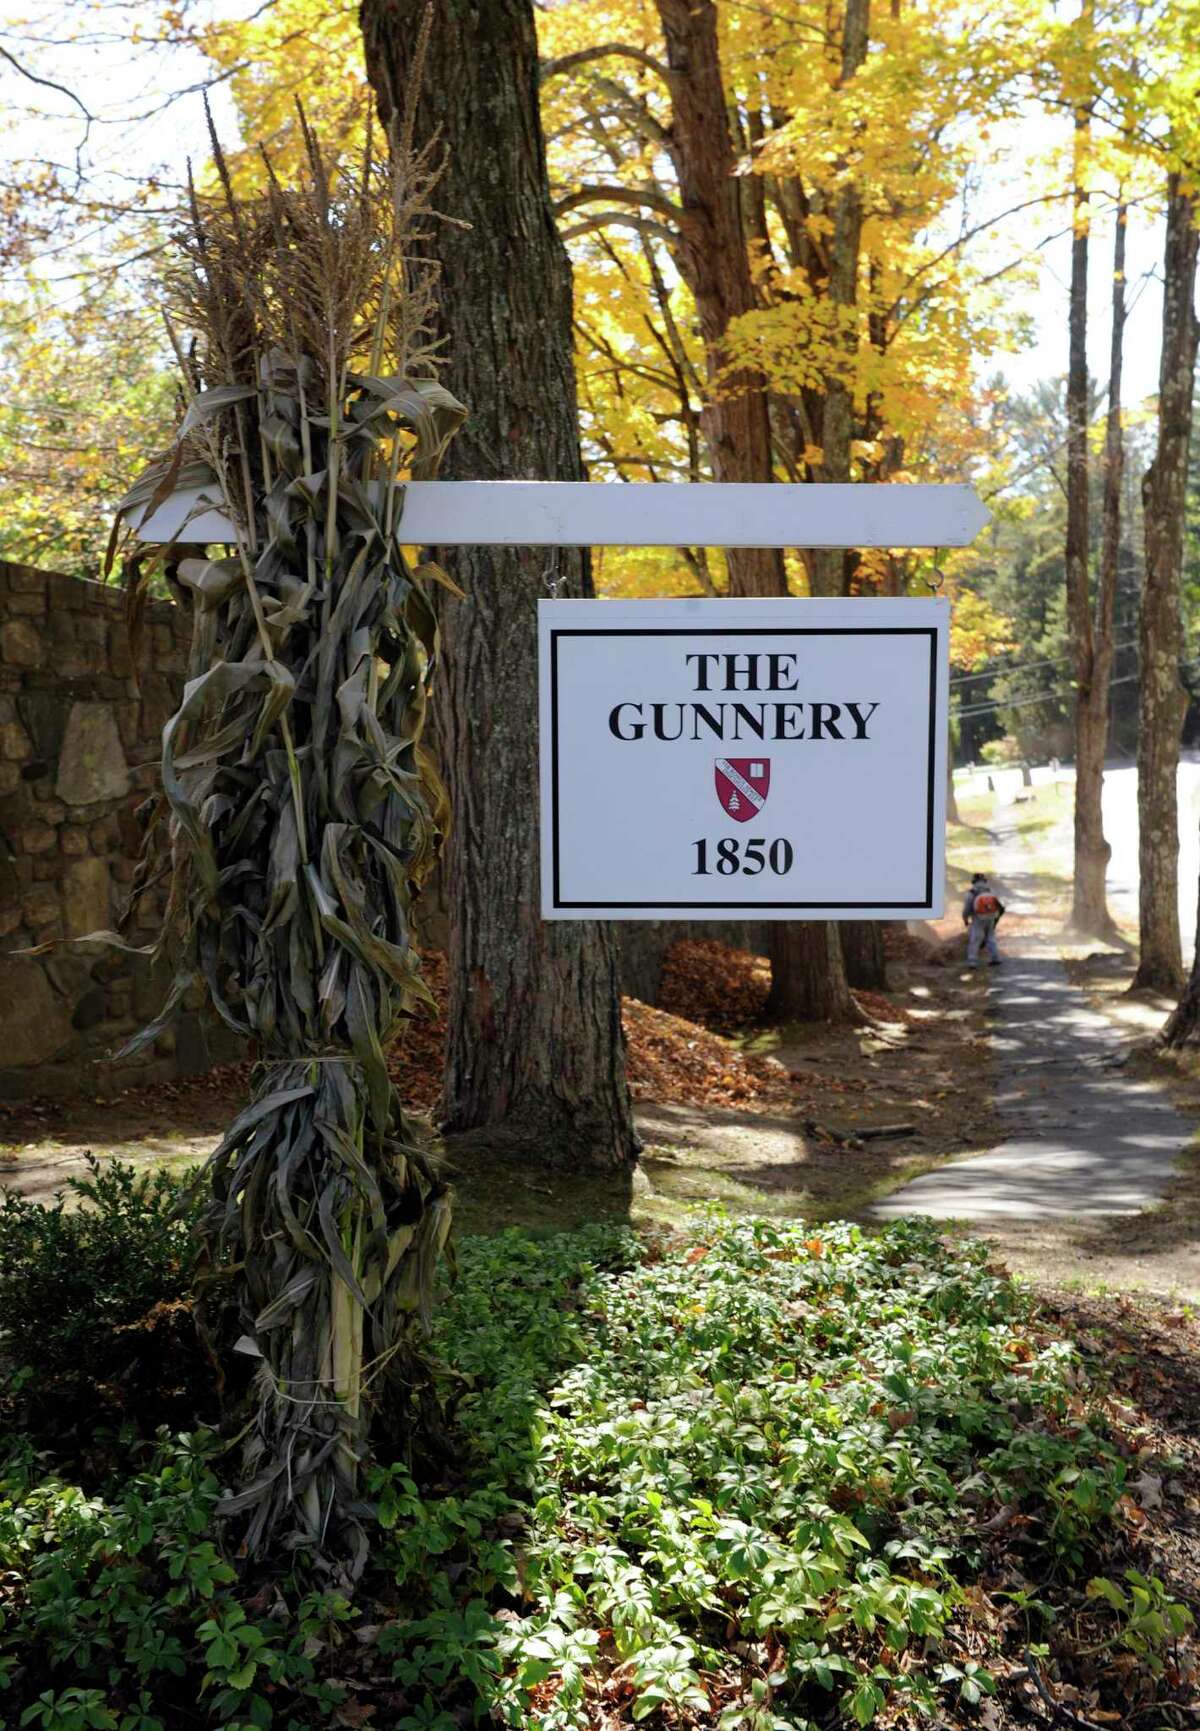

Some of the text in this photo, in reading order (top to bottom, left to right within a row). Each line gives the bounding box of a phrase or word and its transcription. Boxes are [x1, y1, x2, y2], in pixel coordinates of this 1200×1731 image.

[686, 653, 799, 692] THE
[608, 702, 881, 742] GUNNERY
[691, 837, 794, 876] 1850
